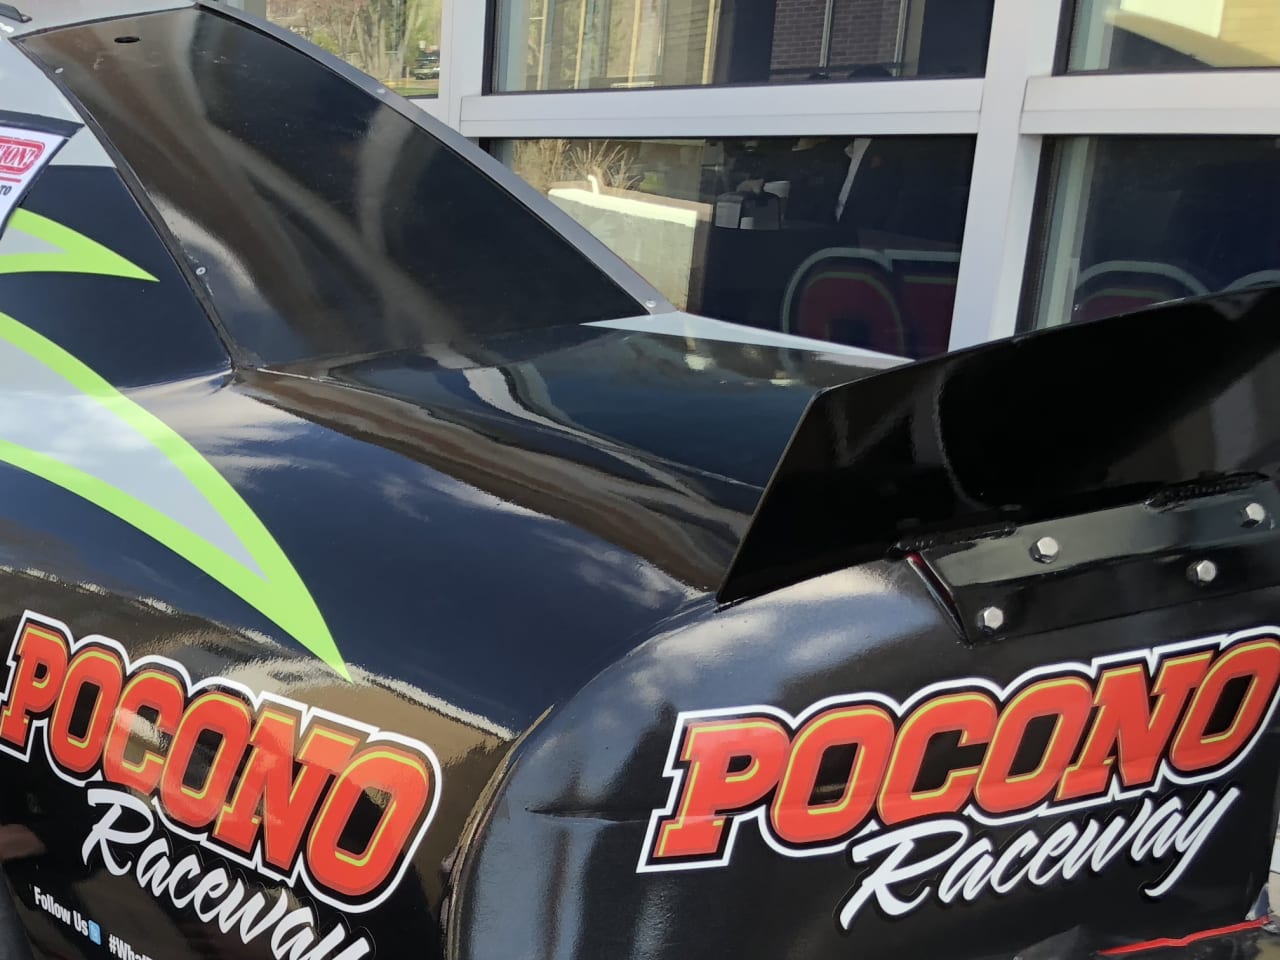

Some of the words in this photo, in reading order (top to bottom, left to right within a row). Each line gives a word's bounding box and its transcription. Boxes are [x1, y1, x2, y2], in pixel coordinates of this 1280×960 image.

[640, 630, 1280, 870] POCONO
[33, 885, 71, 925] Follow
[73, 910, 89, 937] Us
[839, 787, 1239, 930] Raceway
